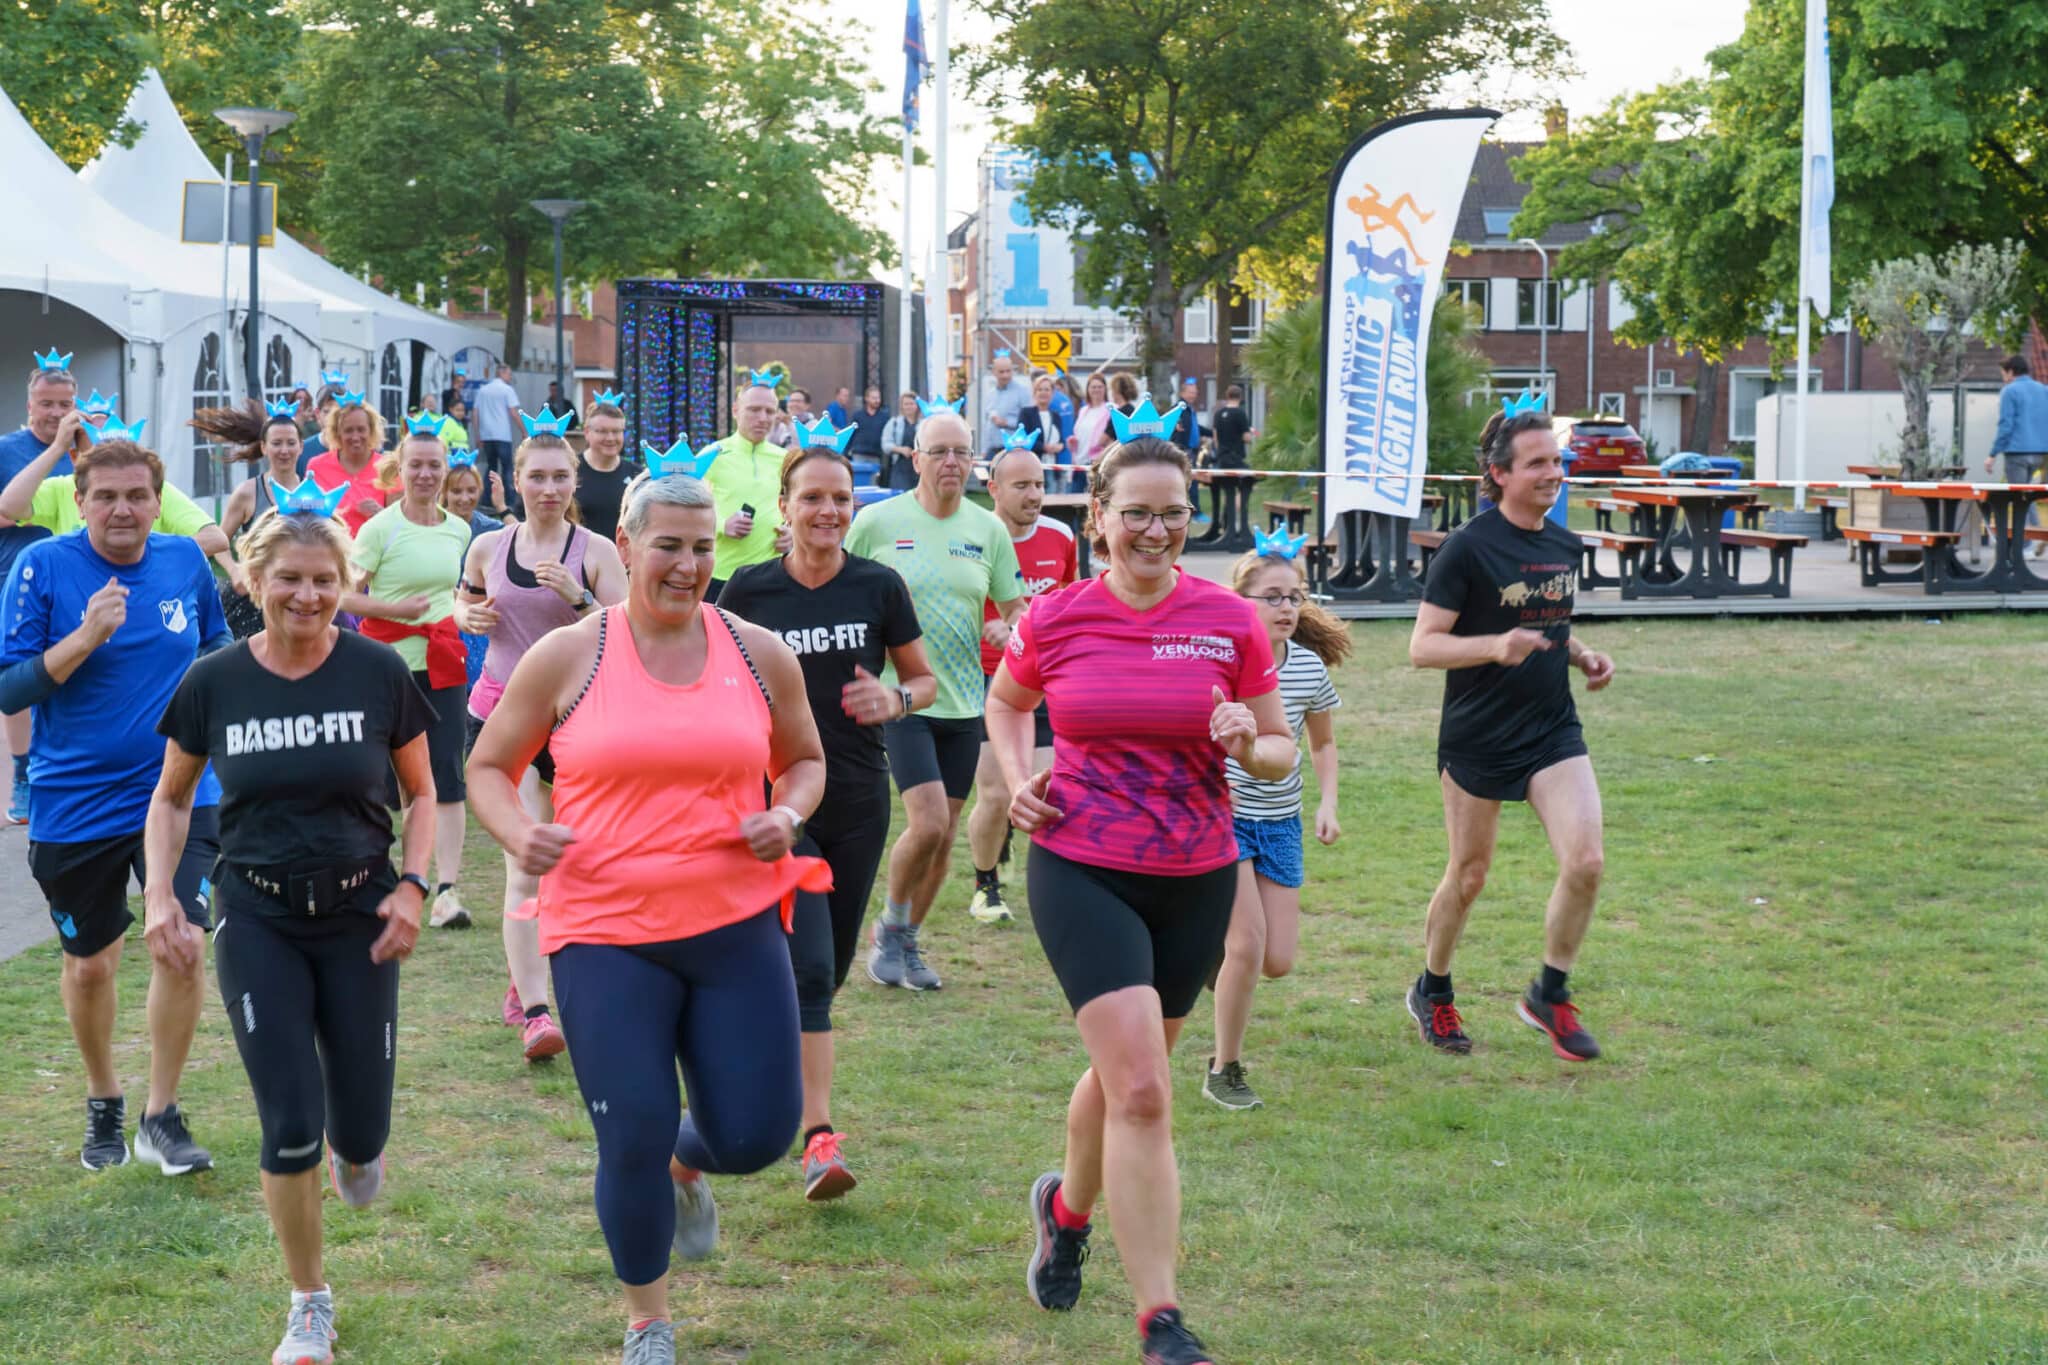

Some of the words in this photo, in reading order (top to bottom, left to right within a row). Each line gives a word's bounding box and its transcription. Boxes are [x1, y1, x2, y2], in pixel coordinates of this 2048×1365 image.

[1039, 337, 1050, 351] B
[1339, 295, 1355, 404] VENLOOP
[1386, 331, 1417, 401] RUN
[1345, 314, 1384, 482] DYNAMIC
[1375, 401, 1415, 500] NIGHT
[773, 623, 867, 655] SIC-FIT
[1152, 644, 1235, 657] VENLOOP
